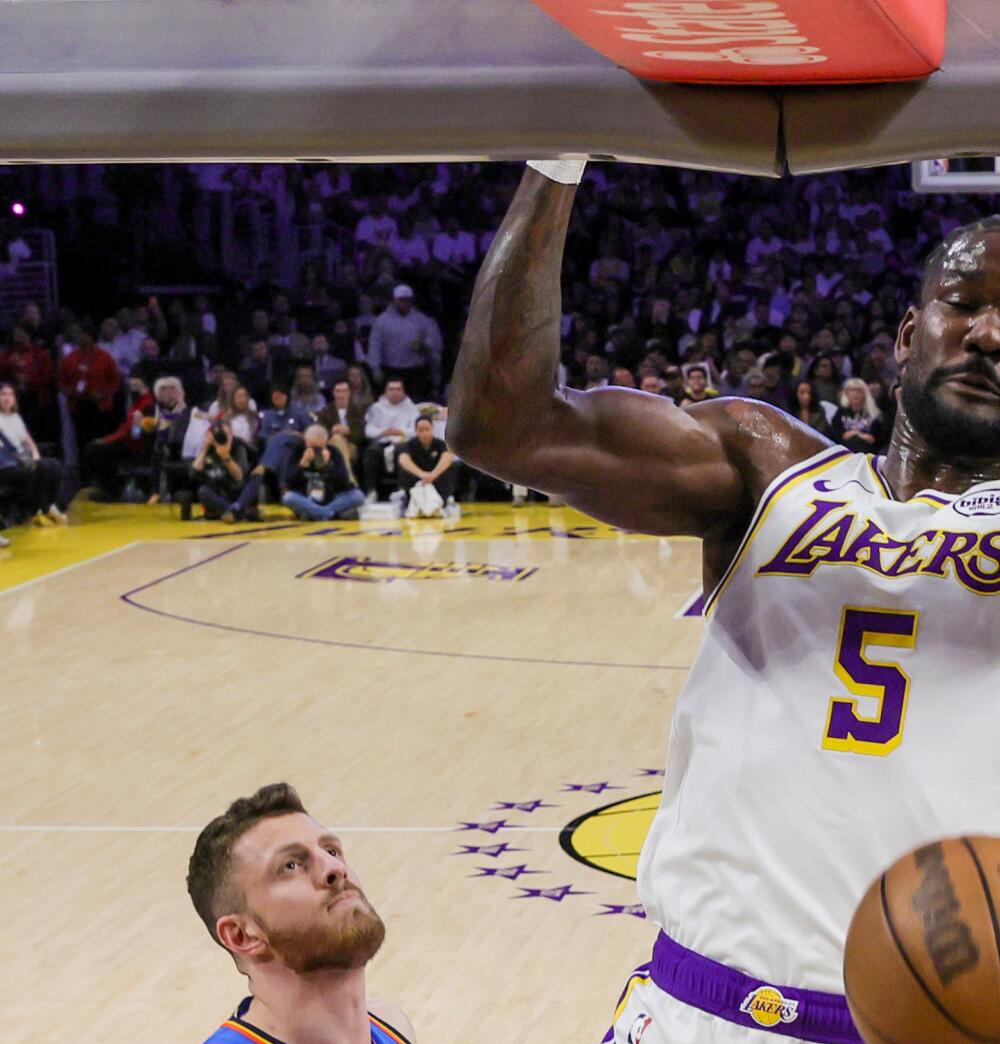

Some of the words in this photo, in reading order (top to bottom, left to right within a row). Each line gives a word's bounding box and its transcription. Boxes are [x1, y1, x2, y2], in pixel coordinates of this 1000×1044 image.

[593, 1, 808, 46] State
[821, 604, 921, 757] 5
[744, 994, 797, 1021] LAKERS
